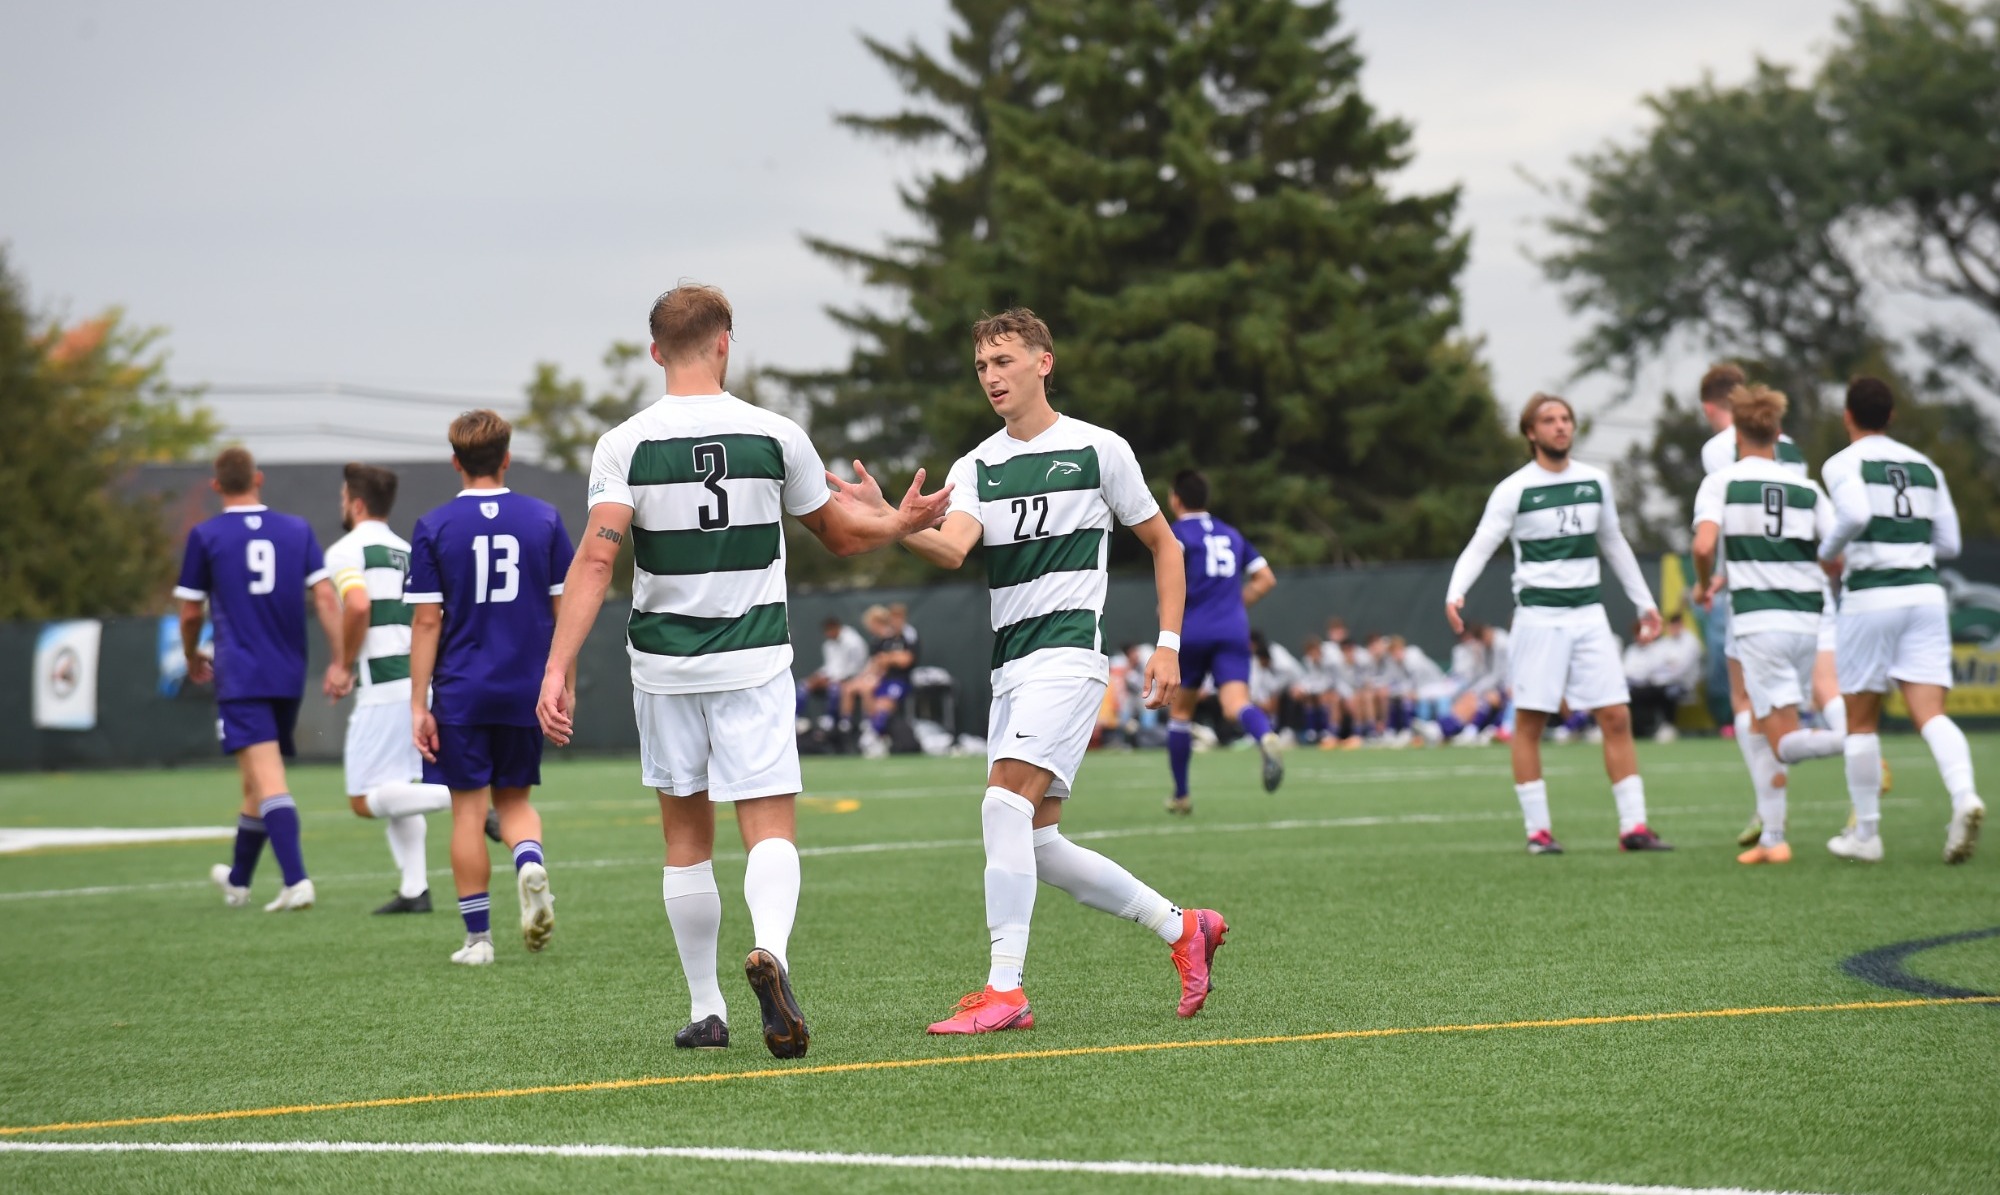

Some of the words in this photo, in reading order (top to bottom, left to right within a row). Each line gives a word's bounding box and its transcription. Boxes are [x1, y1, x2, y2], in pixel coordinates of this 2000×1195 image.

[692, 442, 730, 532] 3
[1762, 483, 1787, 541] 9
[1885, 464, 1916, 522] 8
[1011, 496, 1050, 541] 22
[1556, 504, 1583, 535] 24
[246, 539, 276, 595] 9
[472, 534, 520, 604] 13
[1203, 534, 1236, 578] 15
